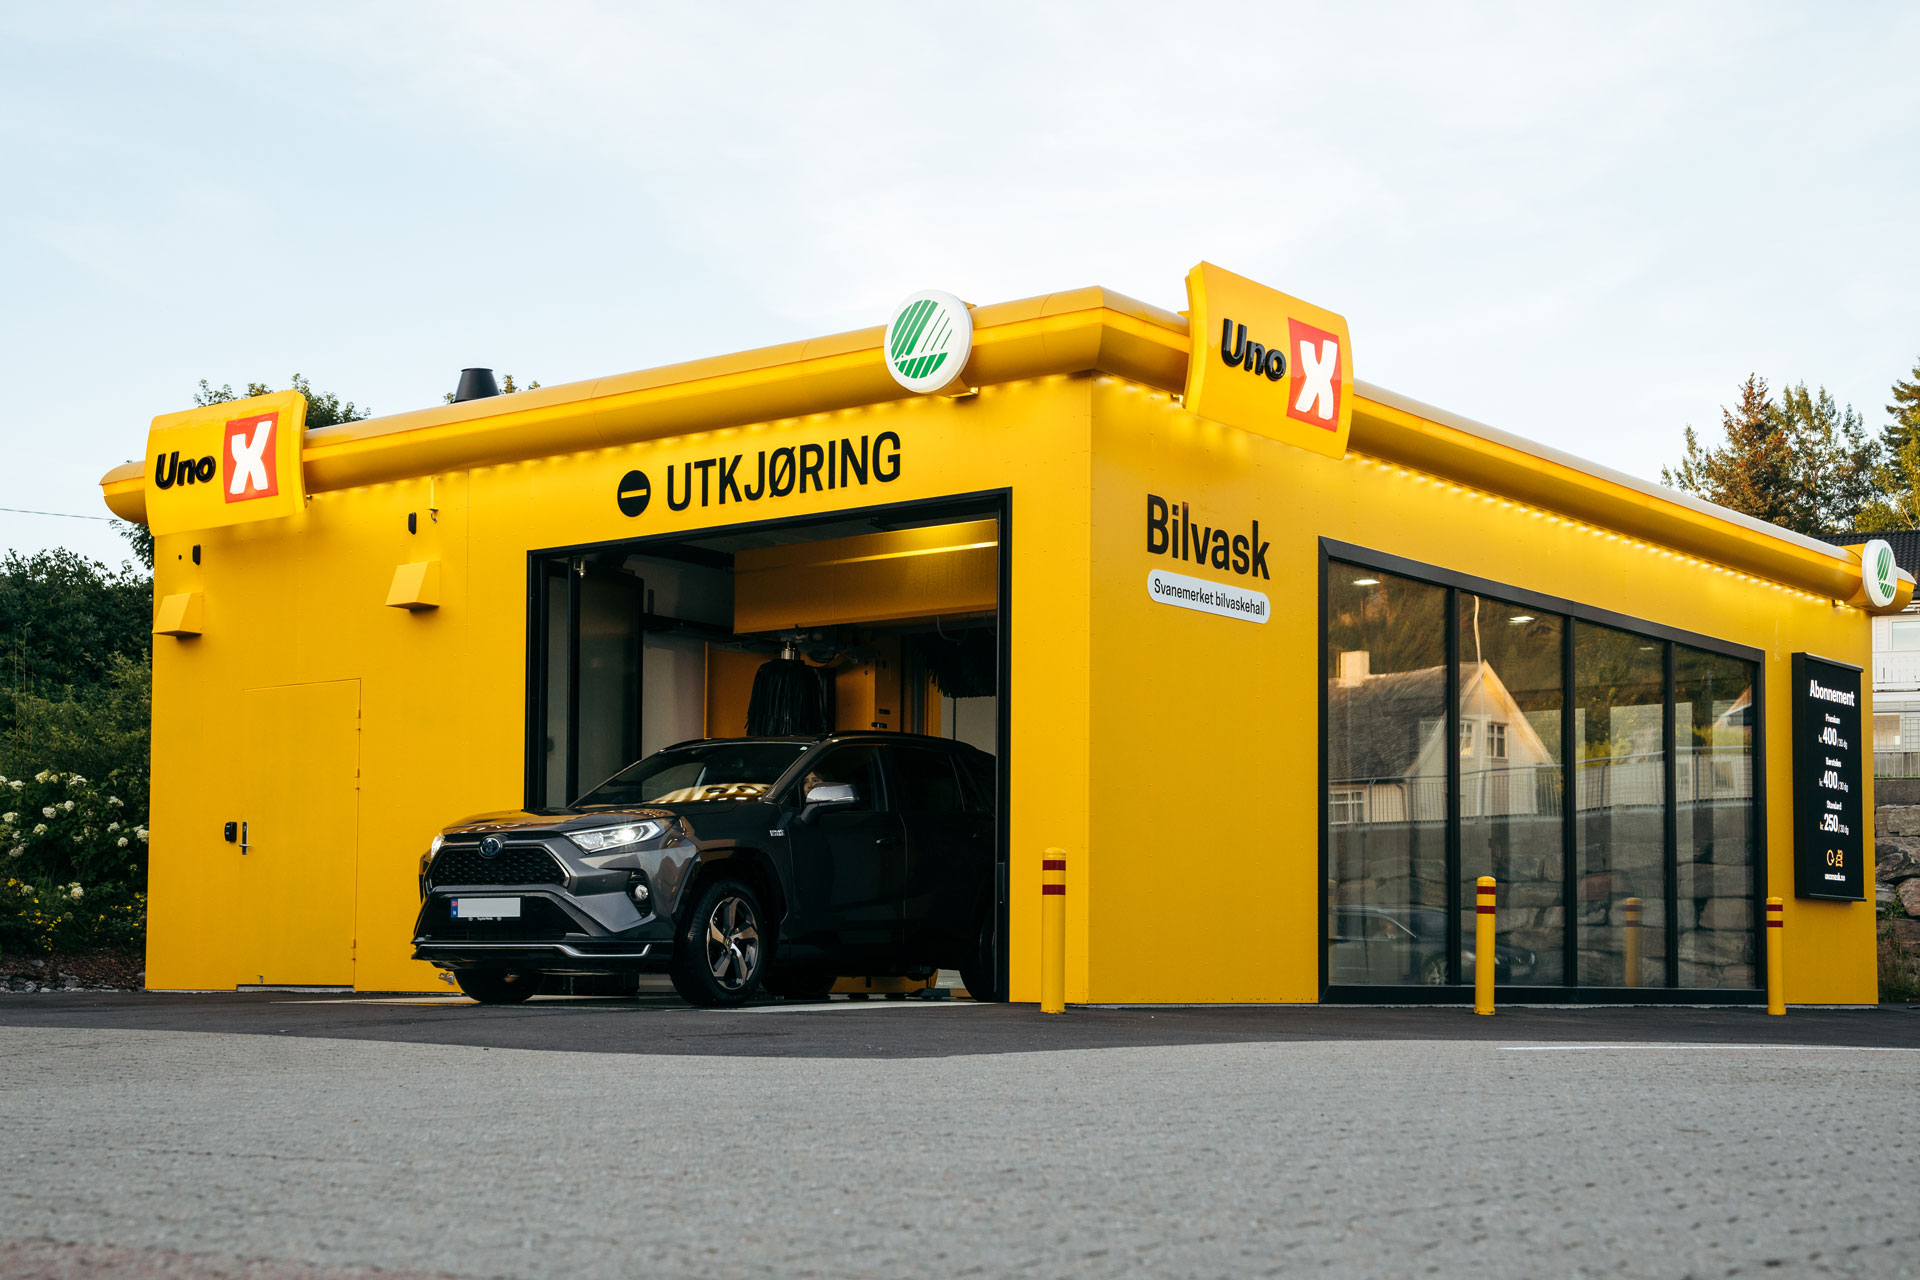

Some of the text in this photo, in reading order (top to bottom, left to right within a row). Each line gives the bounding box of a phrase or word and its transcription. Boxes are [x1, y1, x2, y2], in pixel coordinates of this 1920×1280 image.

[1221, 318, 1338, 420] Uno X
[155, 420, 273, 494] Uno X
[667, 431, 901, 511] UTKJØRING
[1147, 493, 1270, 580] Bilvask
[1154, 578, 1265, 616] Svanemerket bilvaskehall
[1809, 680, 1855, 707] Abonnement
[1823, 727, 1837, 746] 400
[1823, 770, 1838, 789] 400
[1824, 813, 1838, 832] 250
